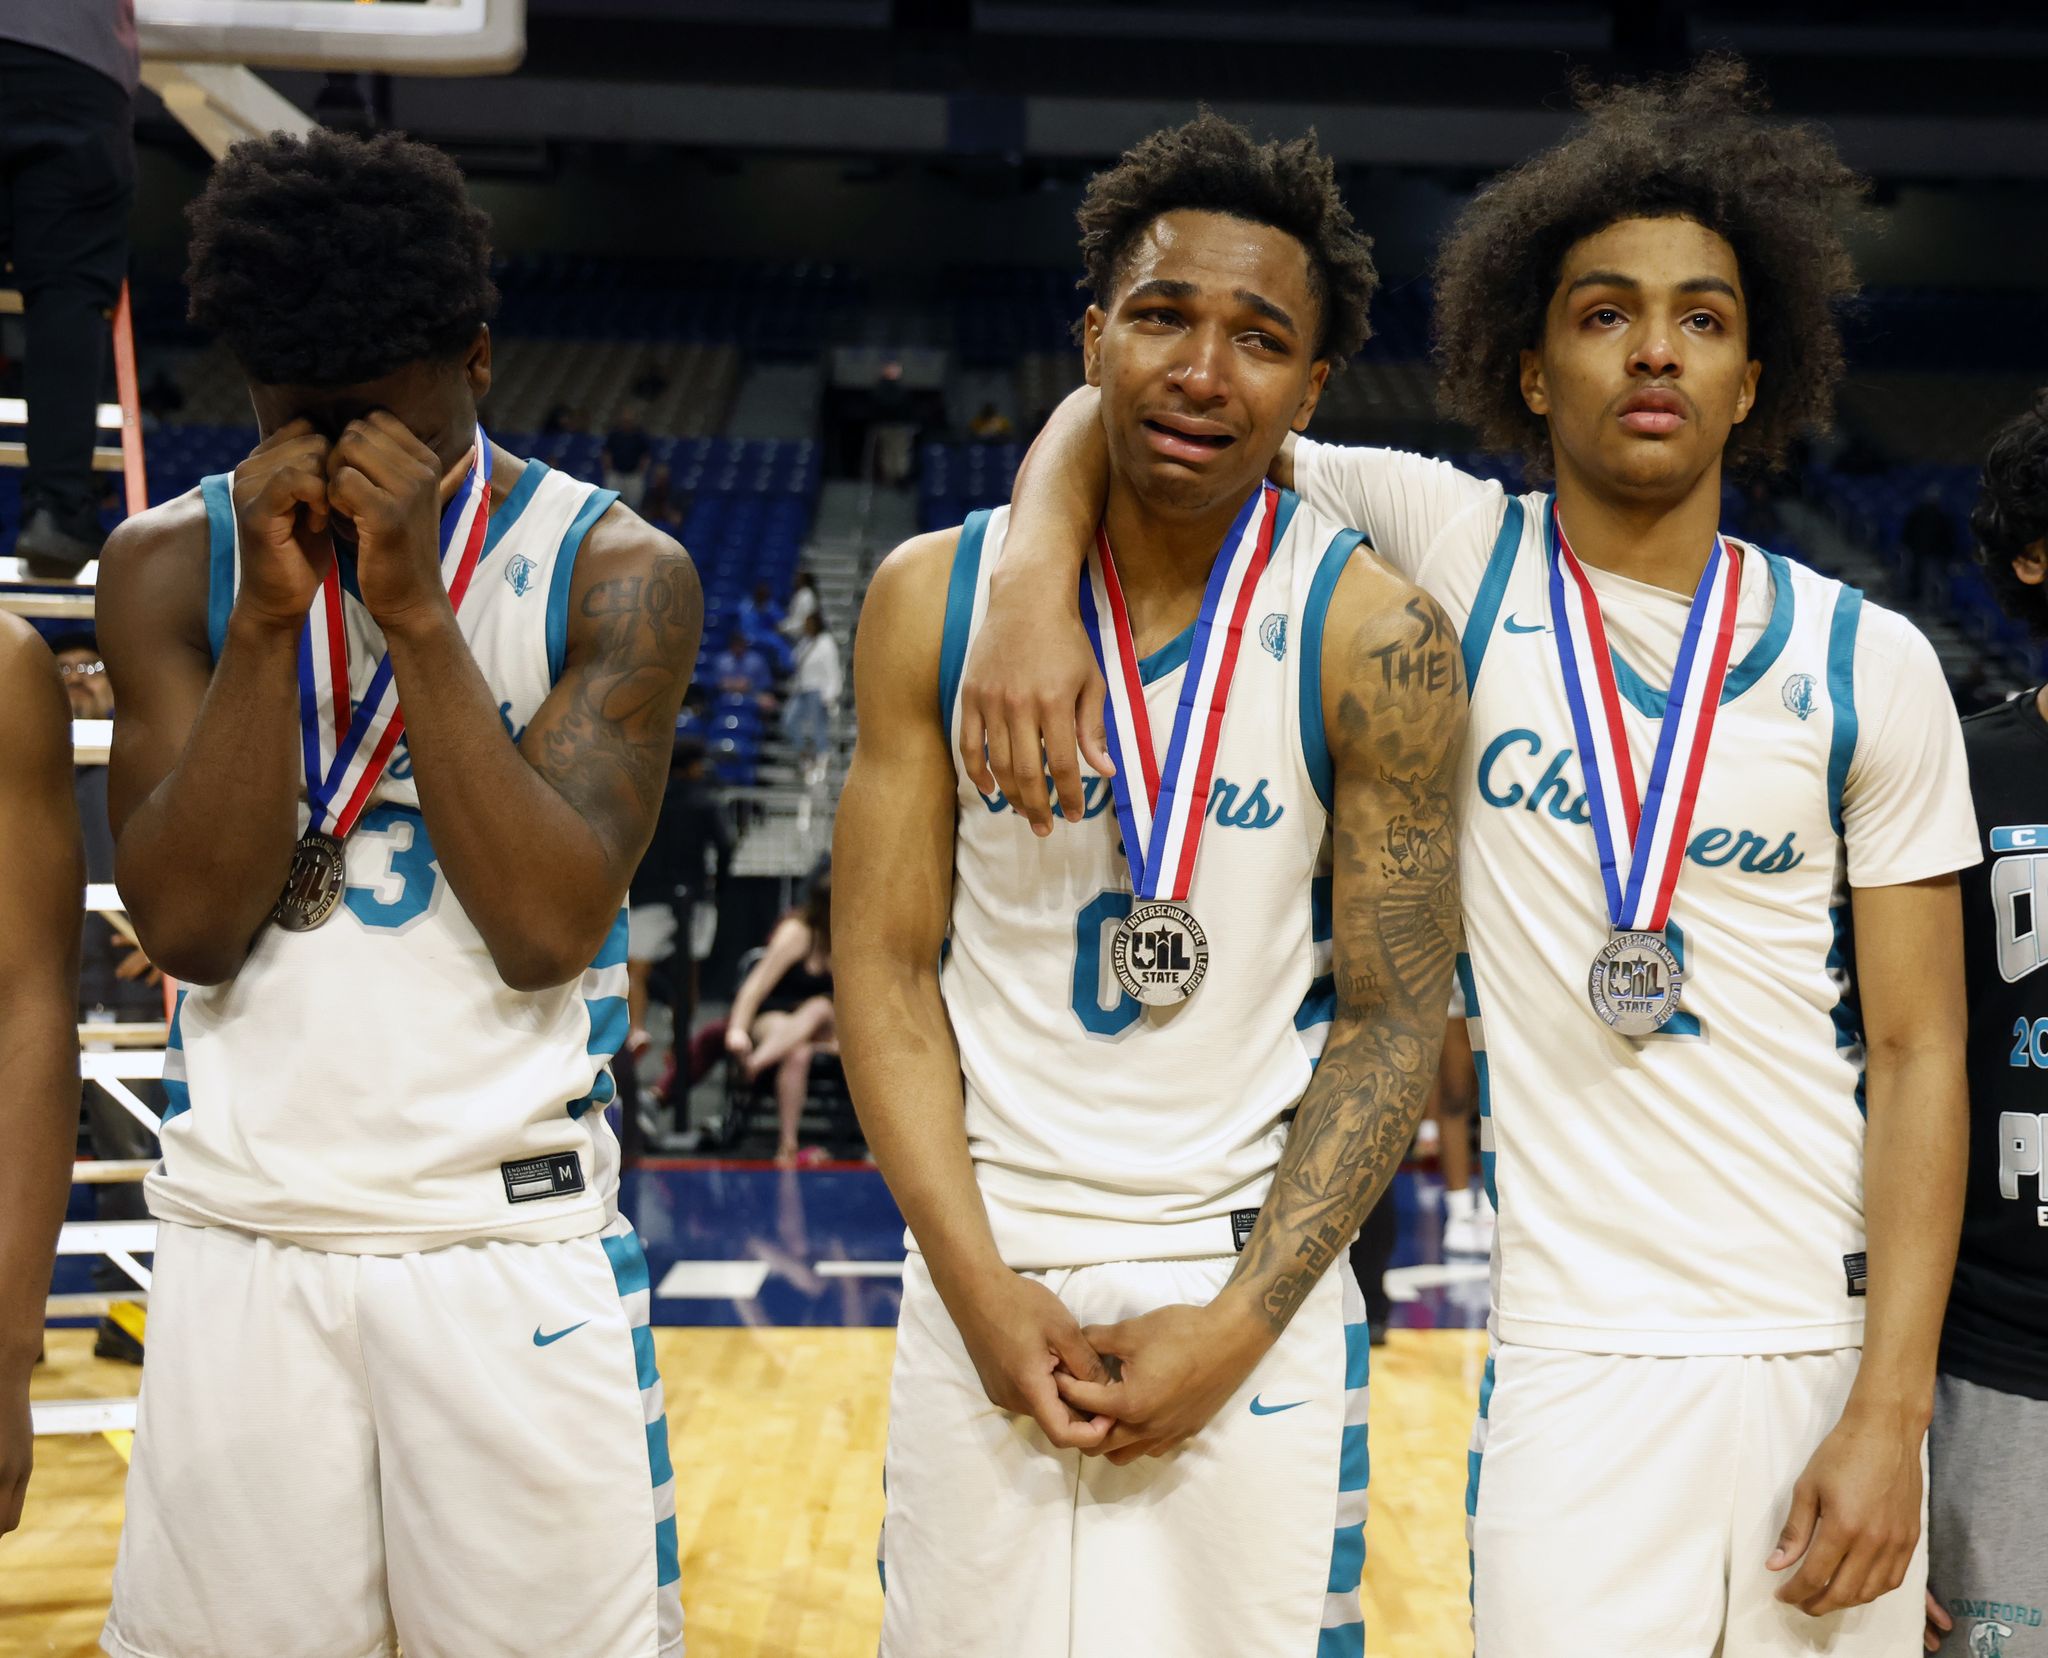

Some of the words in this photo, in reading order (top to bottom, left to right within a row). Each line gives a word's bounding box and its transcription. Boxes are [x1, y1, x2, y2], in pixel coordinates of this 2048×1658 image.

[1126, 906, 1207, 947] INTERSCHOLASTIC
[1131, 925, 1191, 970] UIL
[1114, 934, 1142, 996] UNIVERSITY
[1141, 971, 1179, 983] STATE
[1182, 952, 1208, 995] LEAGUE
[1608, 955, 1665, 999] UIL
[1617, 1001, 1653, 1012] STATE
[558, 1164, 573, 1182] M
